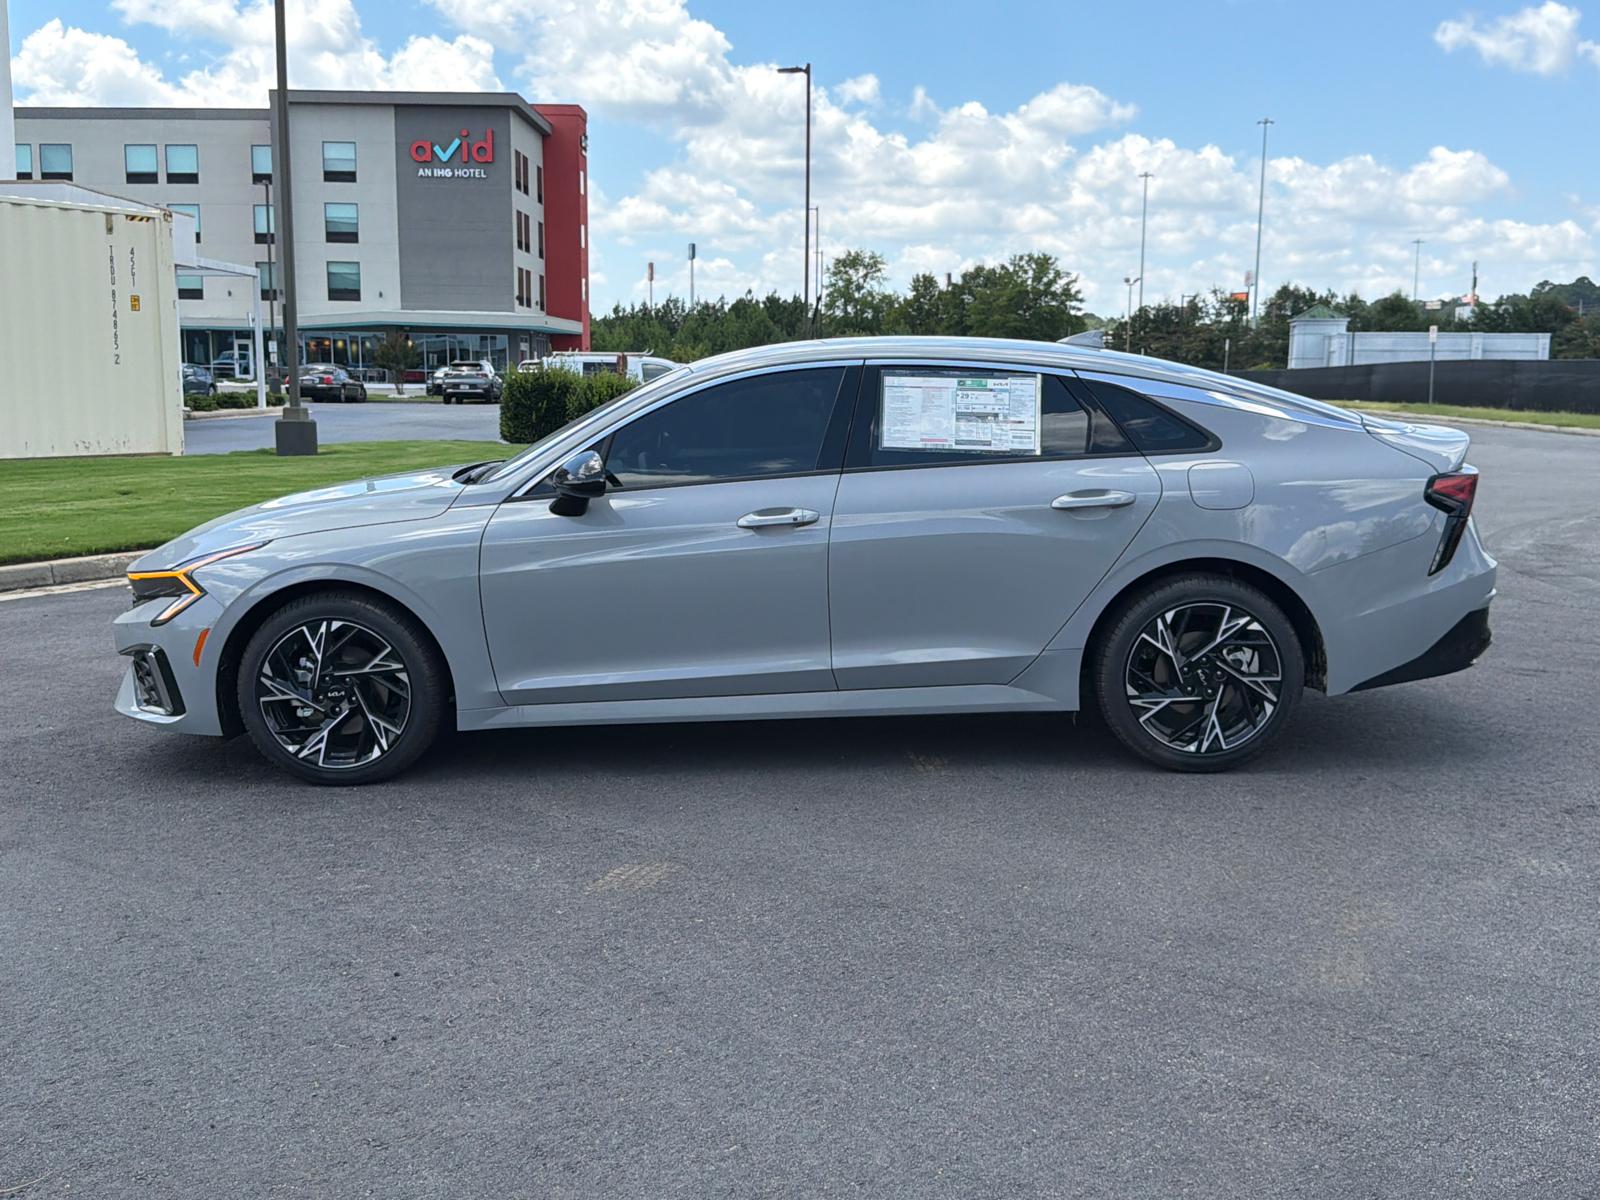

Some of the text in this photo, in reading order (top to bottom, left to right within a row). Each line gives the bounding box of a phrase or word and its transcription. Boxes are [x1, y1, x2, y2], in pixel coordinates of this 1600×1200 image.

[410, 128, 494, 163] avid
[417, 168, 487, 178] AN IHG HOTEL
[114, 354, 120, 365] 2
[327, 690, 345, 698] KIA
